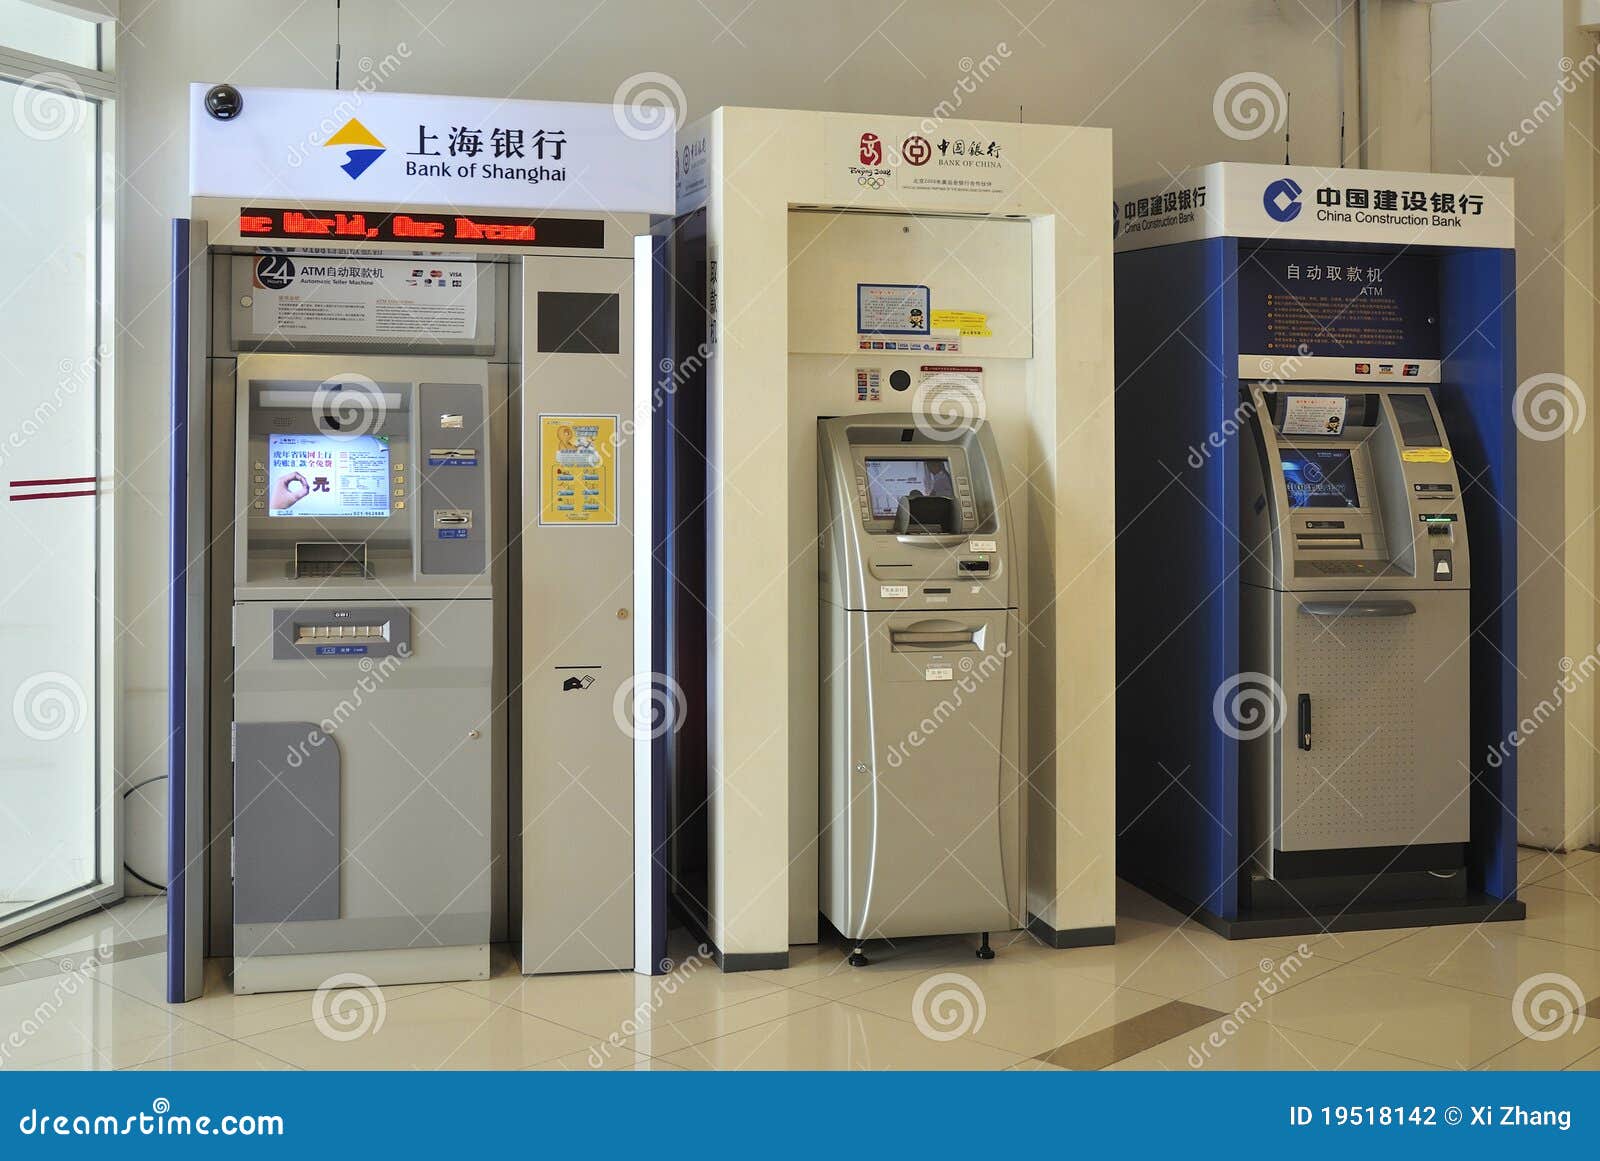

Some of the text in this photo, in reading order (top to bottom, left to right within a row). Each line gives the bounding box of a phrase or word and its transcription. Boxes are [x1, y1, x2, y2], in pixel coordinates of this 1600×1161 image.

[406, 124, 567, 160] 上海银行
[406, 161, 567, 185] Bank of Shanghai
[849, 166, 872, 176] Beijing
[938, 159, 959, 167] BANK
[1124, 186, 1206, 220] 中国建设银行
[1316, 187, 1483, 215] 中国建设银行
[1124, 212, 1195, 233] China Construction Bank
[1316, 209, 1461, 227] China Construction Bank
[260, 255, 295, 284] 24
[1287, 263, 1383, 283] 自动取款机
[1359, 286, 1383, 296] ATM
[312, 476, 330, 492] 元
